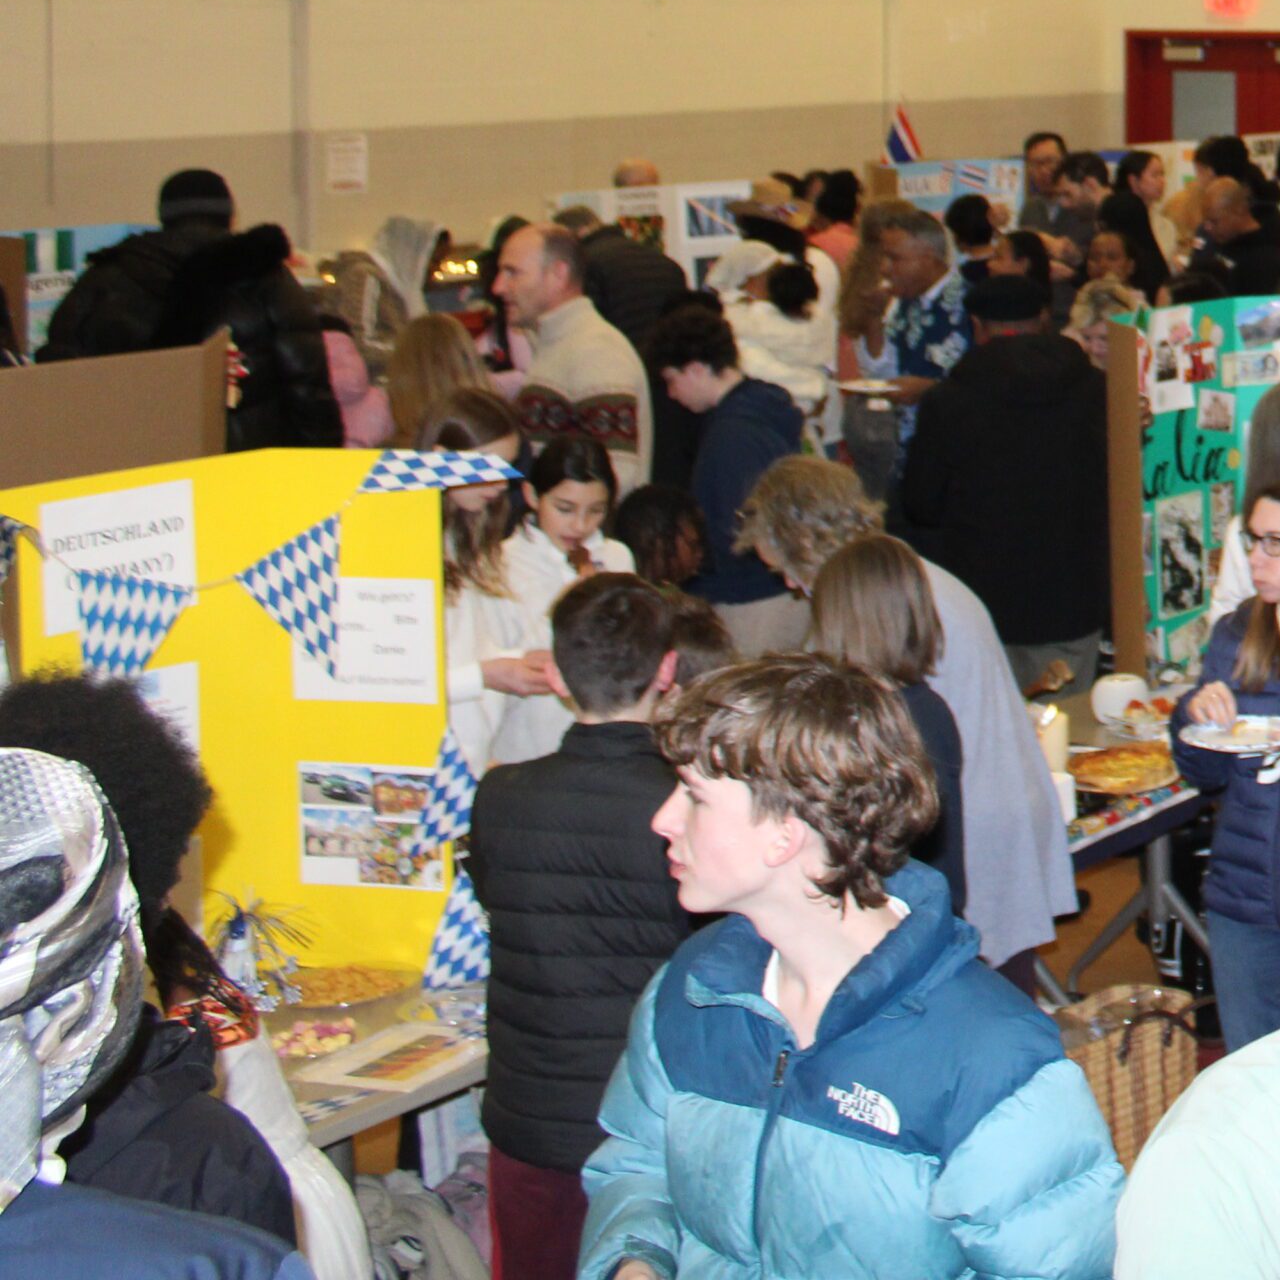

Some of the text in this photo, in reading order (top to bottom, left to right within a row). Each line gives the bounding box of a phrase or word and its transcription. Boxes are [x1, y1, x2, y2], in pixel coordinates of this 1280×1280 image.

[52, 515, 185, 554] DEUTSCHLAND
[851, 1081, 880, 1103] THE
[837, 1101, 875, 1126] FACE
